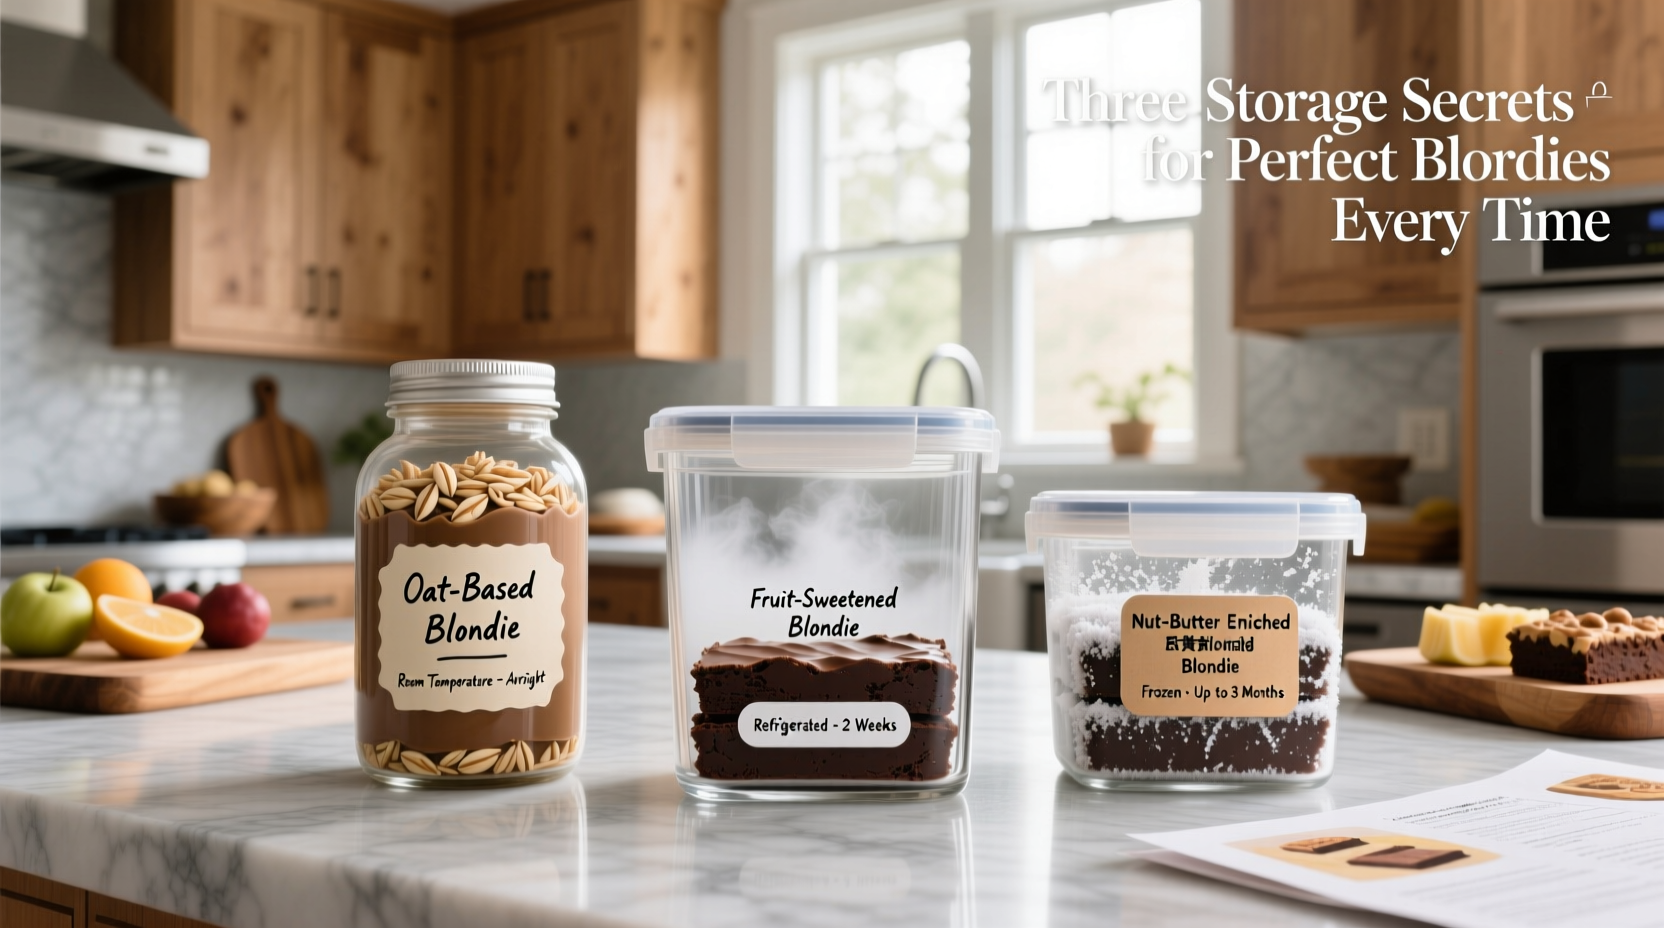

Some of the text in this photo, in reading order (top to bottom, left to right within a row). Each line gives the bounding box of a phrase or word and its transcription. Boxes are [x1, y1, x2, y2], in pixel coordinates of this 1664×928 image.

[403, 569, 536, 605] Oat-Based
[750, 585, 899, 609] Fruit-Sweetened
[424, 609, 521, 645] Blondie
[788, 614, 860, 638] Blondie
[1131, 612, 1291, 630] Nut-Butter Eniched
[1181, 656, 1240, 674] Blondie
[1141, 684, 1182, 699] Frozen
[1194, 684, 1211, 703] Up
[1215, 686, 1228, 699] to
[1230, 685, 1239, 699] 3
[1241, 684, 1285, 699] Months
[842, 718, 851, 732] 2
[855, 716, 897, 732] Weeks
